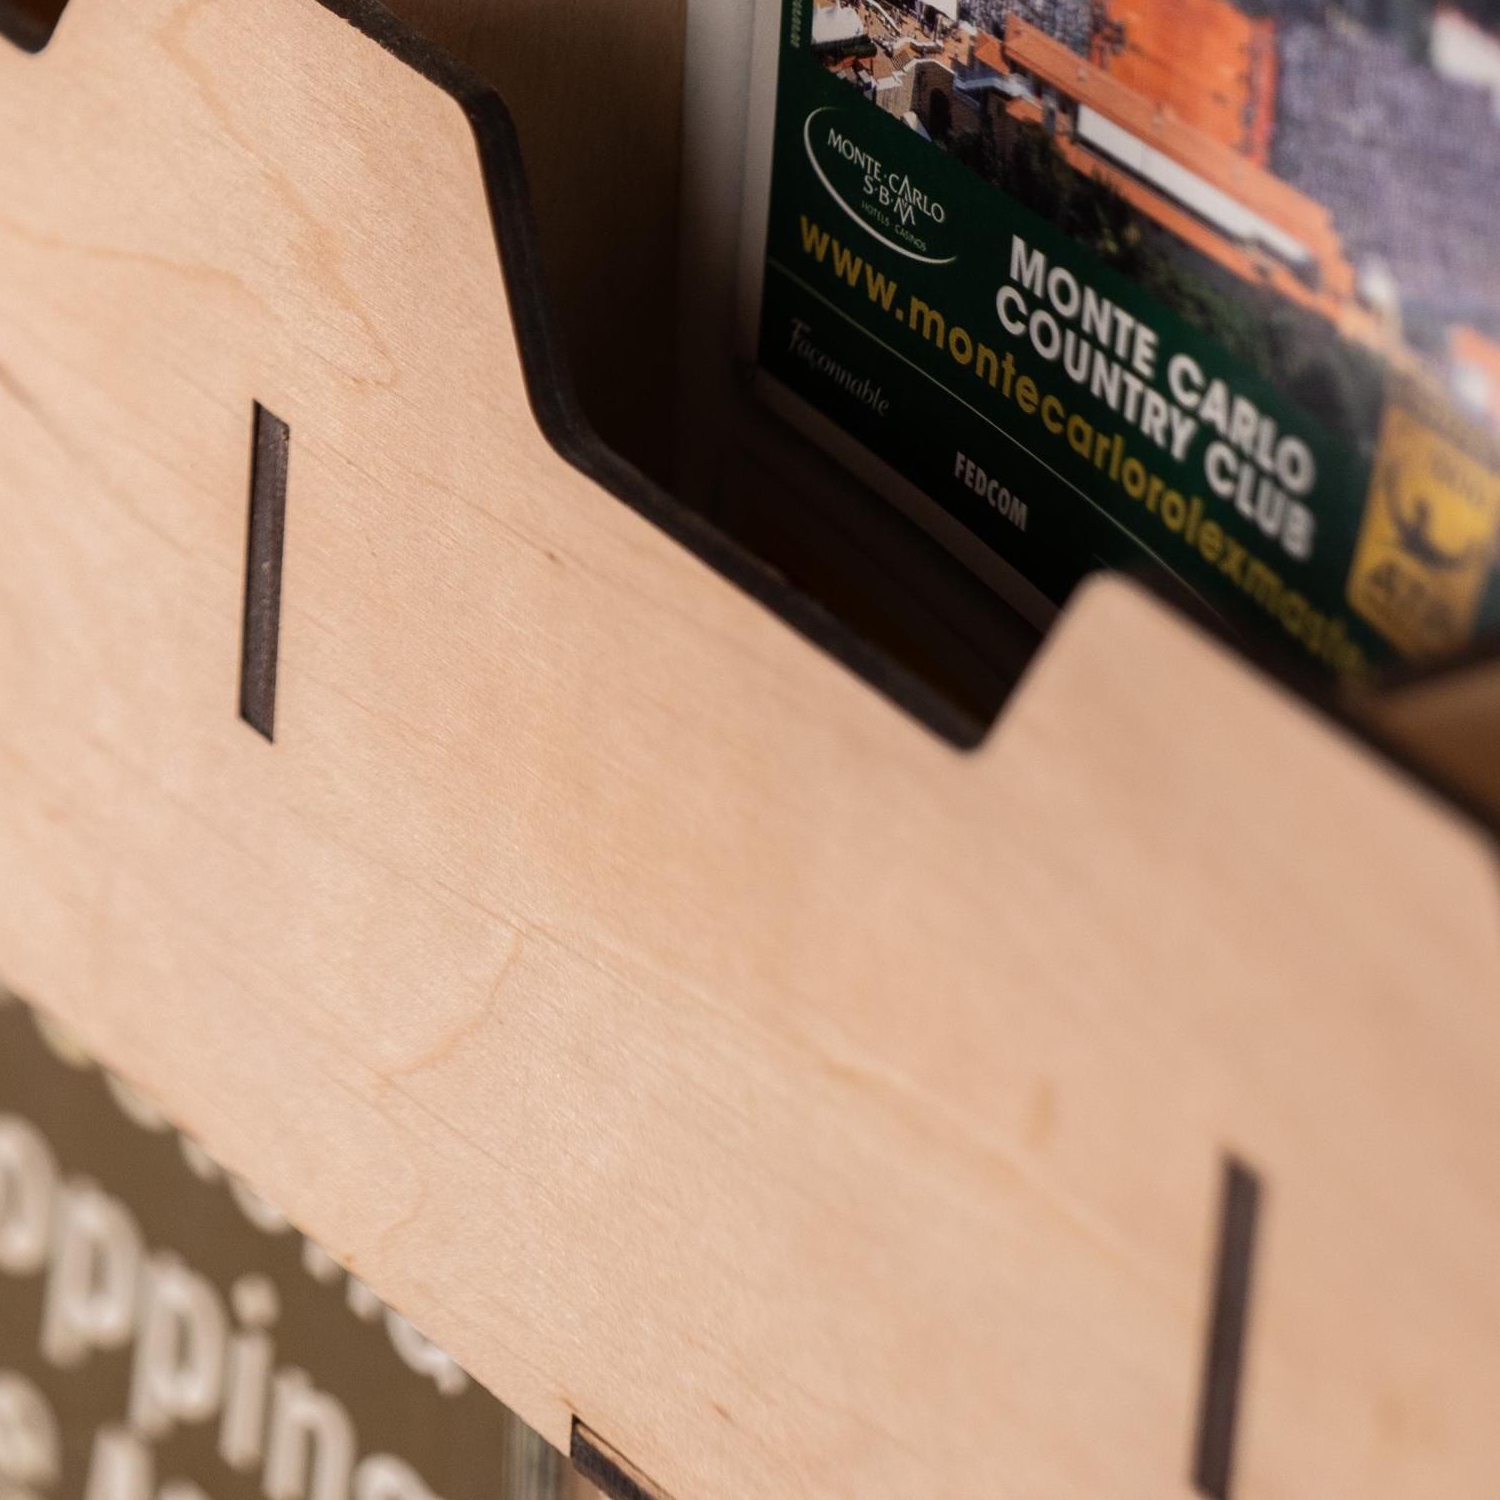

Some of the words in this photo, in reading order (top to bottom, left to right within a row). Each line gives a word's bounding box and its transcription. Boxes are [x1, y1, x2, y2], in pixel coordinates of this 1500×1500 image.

[953, 450, 1029, 533] FEDCOM
[996, 286, 1196, 462] COUNTRY
[1204, 440, 1316, 562] CLUB
[1009, 234, 1158, 379] MONTE
[1167, 353, 1316, 493] CARLO
